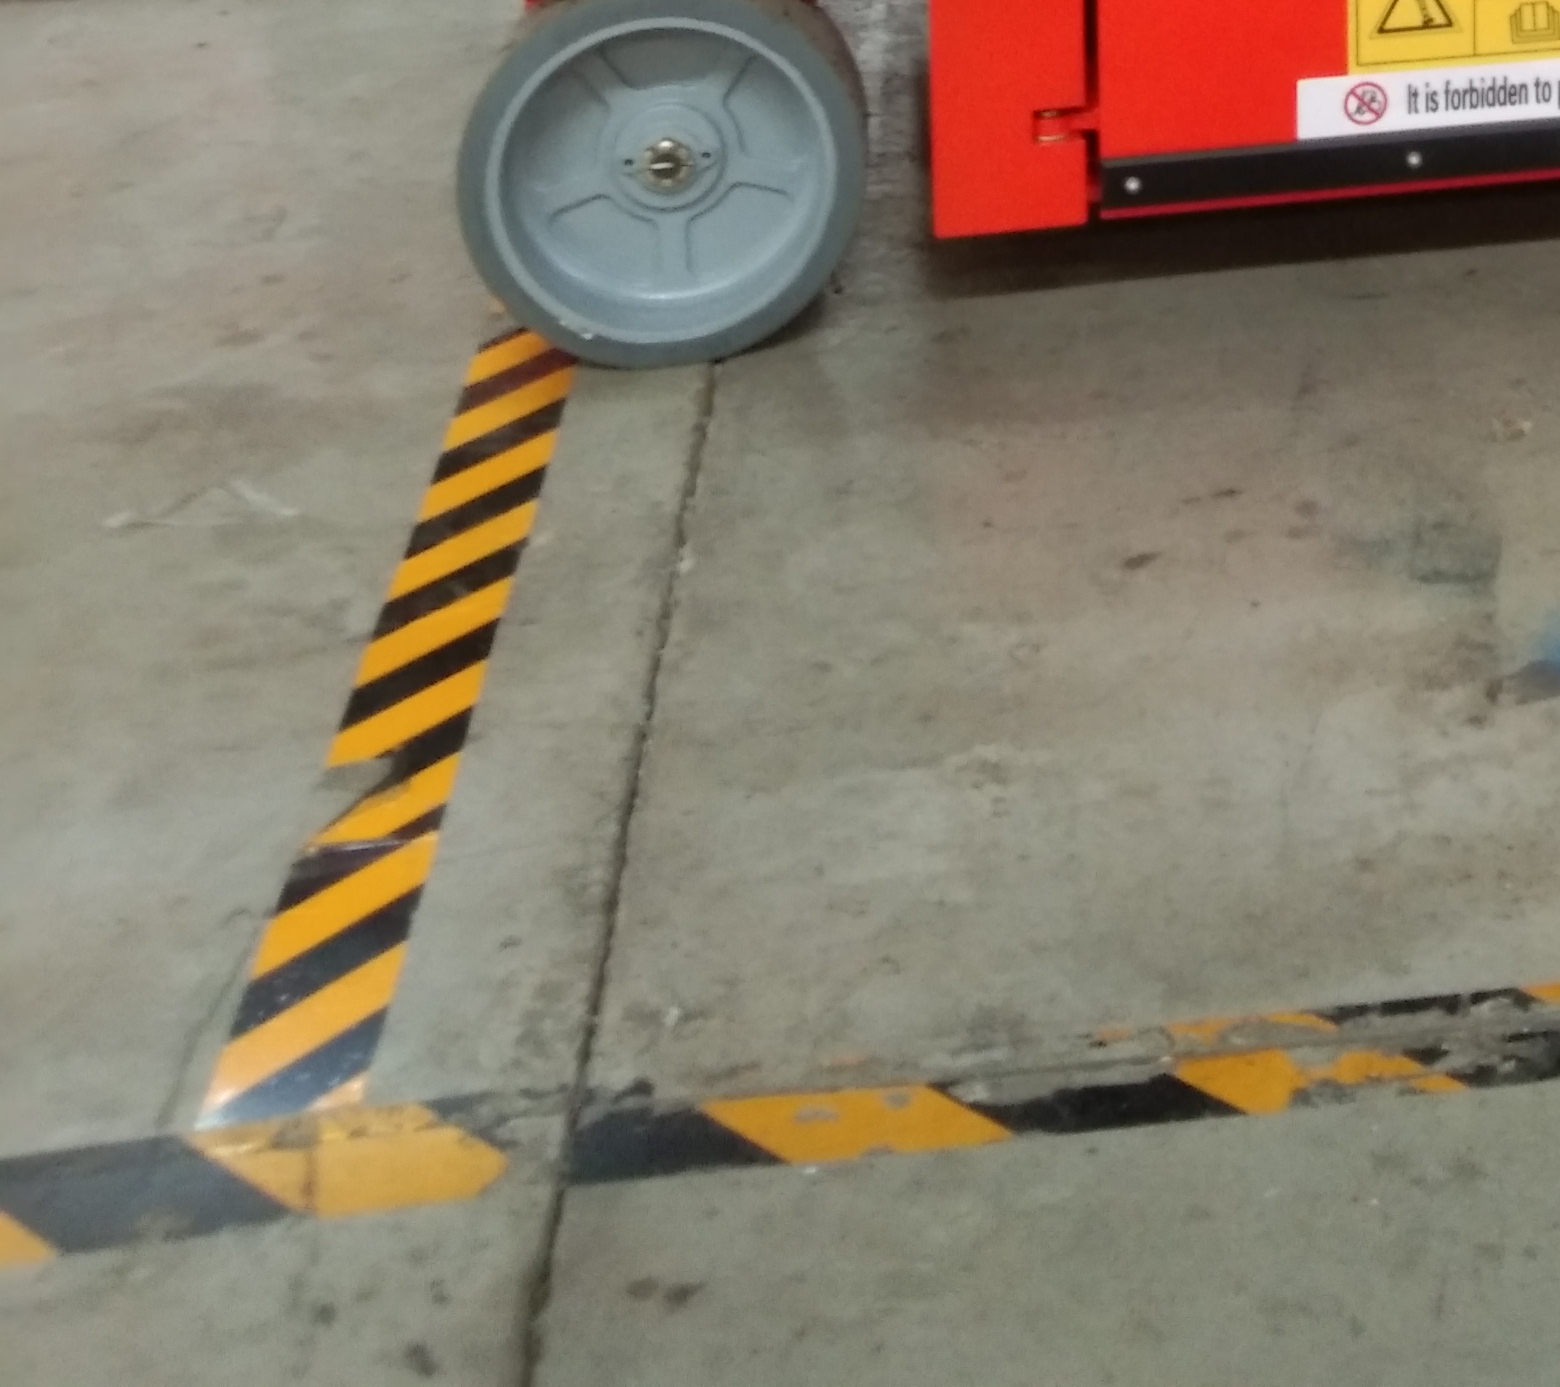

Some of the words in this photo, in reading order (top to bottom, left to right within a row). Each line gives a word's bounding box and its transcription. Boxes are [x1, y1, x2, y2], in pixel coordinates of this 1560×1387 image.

[1407, 83, 1419, 115] It
[1424, 82, 1439, 113] is
[1444, 75, 1529, 112] forbidden
[1534, 80, 1552, 105] to
